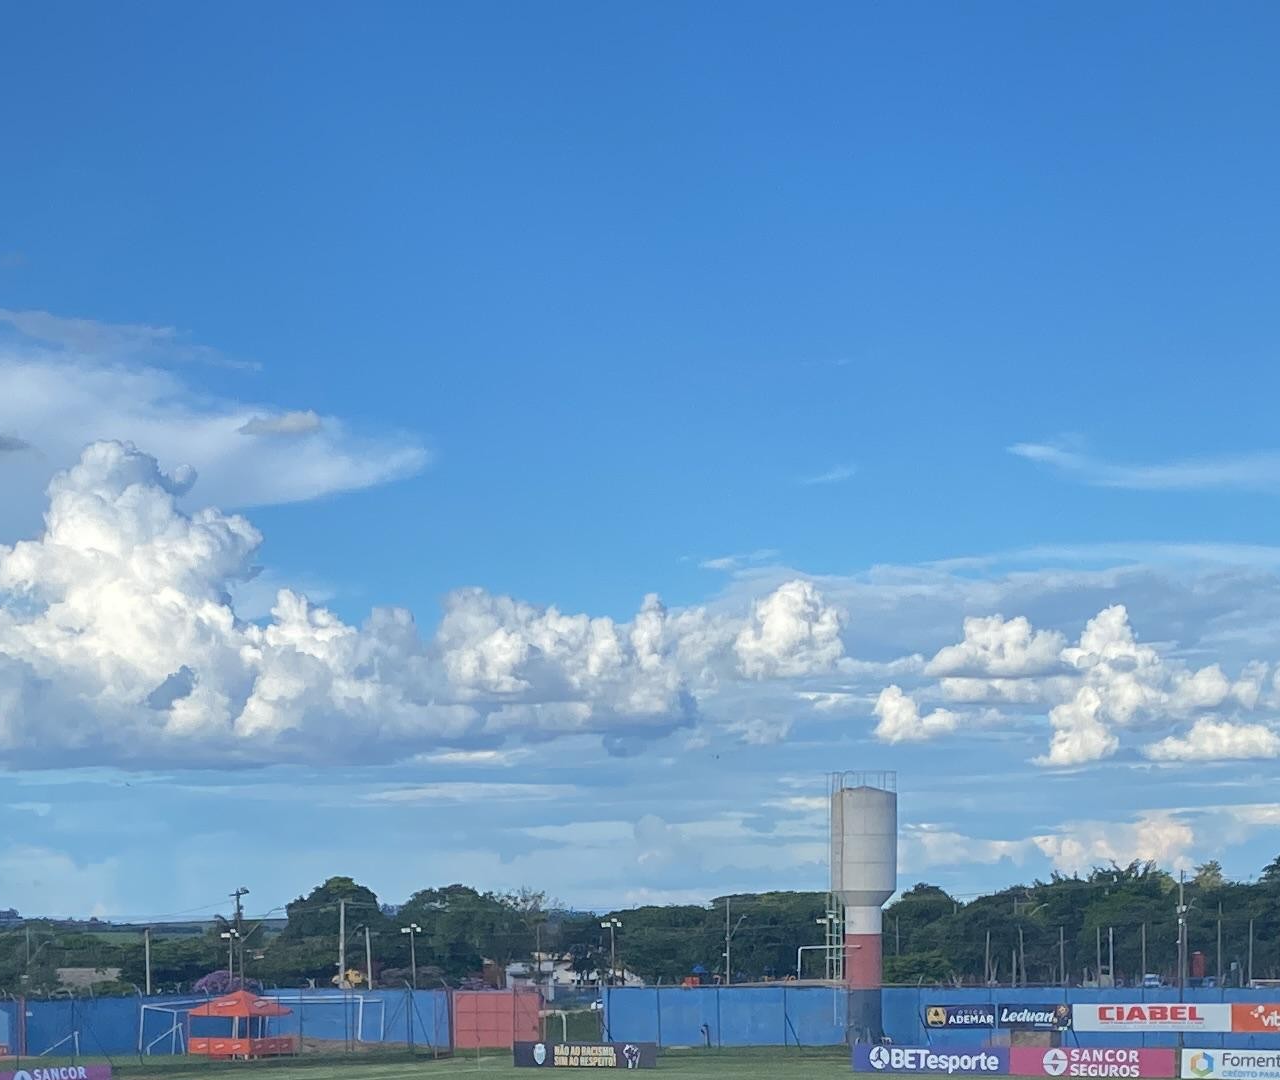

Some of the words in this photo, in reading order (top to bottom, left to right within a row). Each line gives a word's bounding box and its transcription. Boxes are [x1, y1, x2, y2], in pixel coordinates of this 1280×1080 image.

[948, 1014, 994, 1025] ADEMAR
[1098, 1006, 1205, 1021] CIABEL
[554, 1044, 570, 1056] NÃO
[570, 1045, 581, 1056] AO
[1070, 1049, 1140, 1063] SANCOR
[554, 1056, 569, 1066] SIM
[569, 1056, 580, 1066] AO
[890, 1049, 999, 1074] BETesporte
[1070, 1063, 1140, 1078] SEGUROS
[1258, 1070, 1280, 1079] PARA
